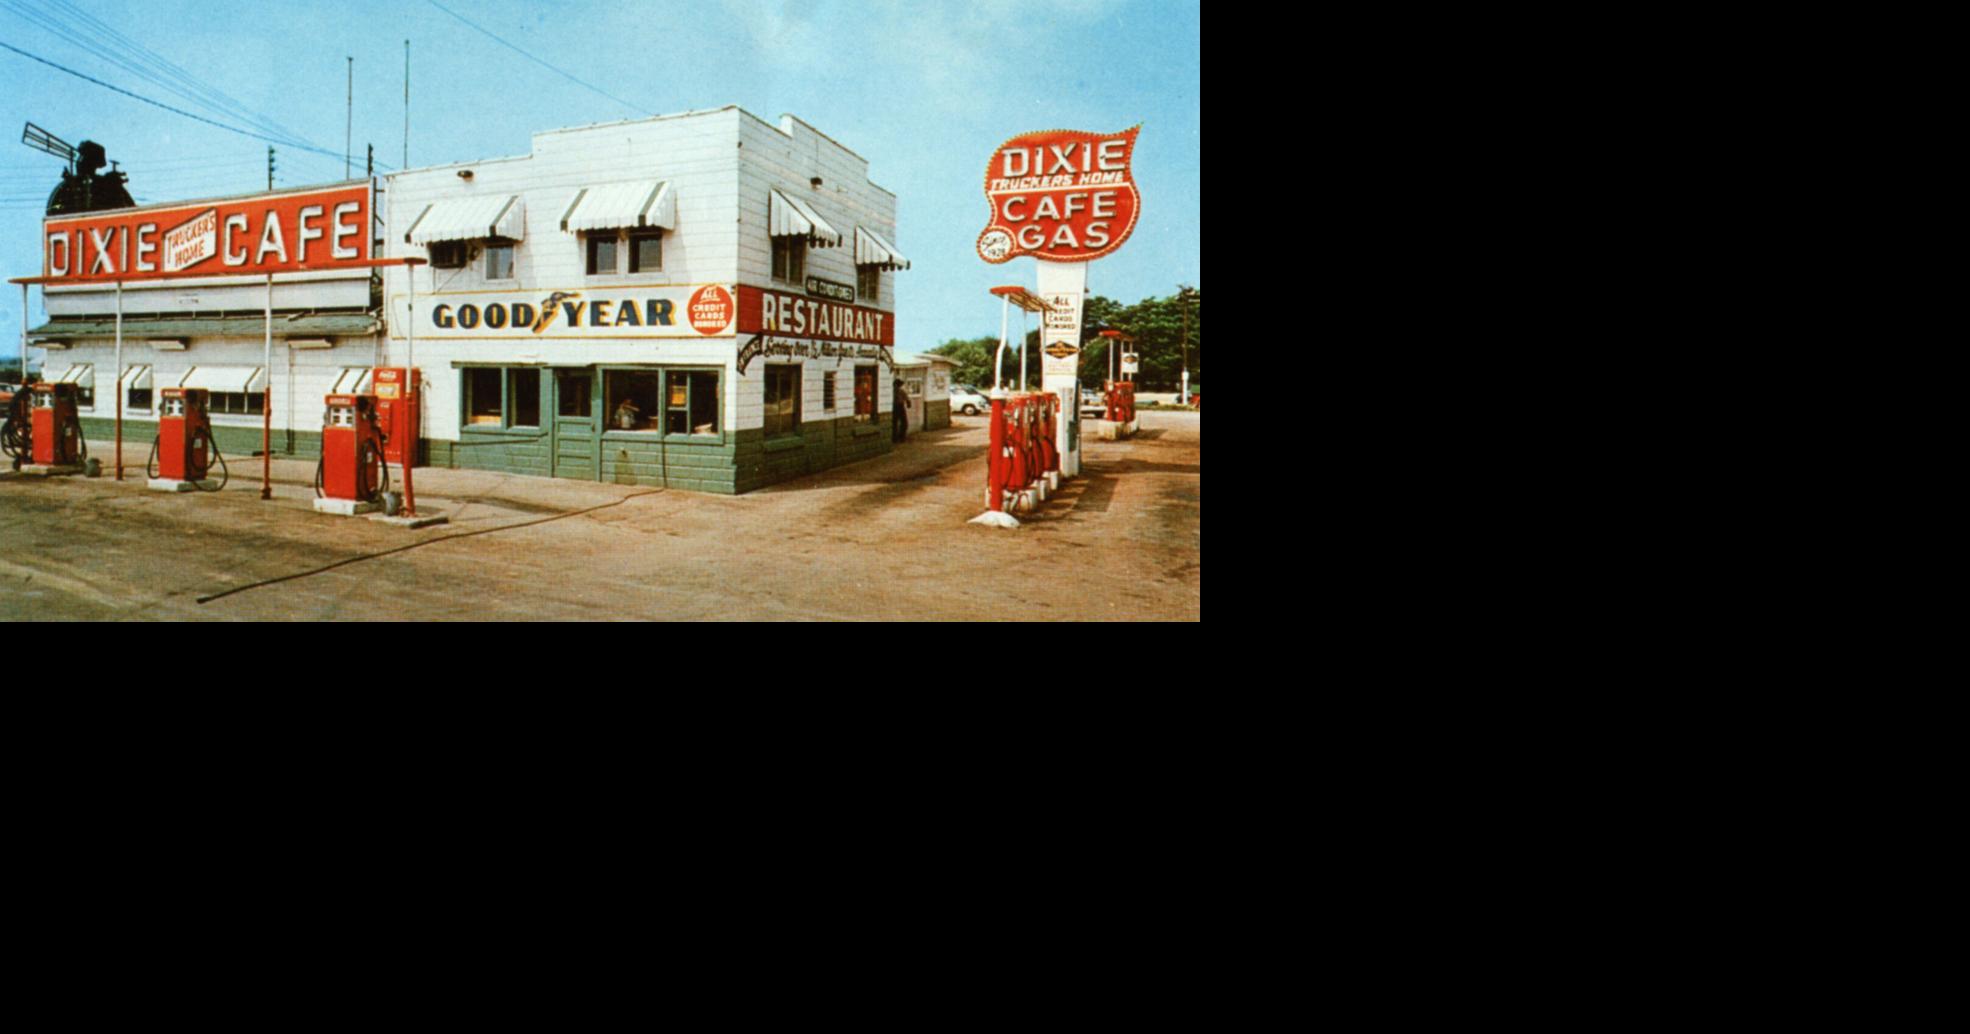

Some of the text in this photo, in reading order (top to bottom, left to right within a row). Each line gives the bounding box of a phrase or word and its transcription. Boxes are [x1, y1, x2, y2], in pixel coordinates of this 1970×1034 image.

[1002, 140, 1126, 177] DIXIE
[991, 171, 1124, 191] TRUCKERS HOME
[1002, 191, 1117, 223] CAFE
[47, 201, 359, 277] DIXIE CAFE
[166, 213, 216, 249] TRUCKERS
[1017, 221, 1110, 250] GAS
[174, 240, 206, 268] HOME
[432, 299, 677, 330] GOOD YEAR
[692, 303, 727, 312] CREDIT
[694, 311, 725, 320] CARDS
[762, 293, 883, 341] RESTAURANT
